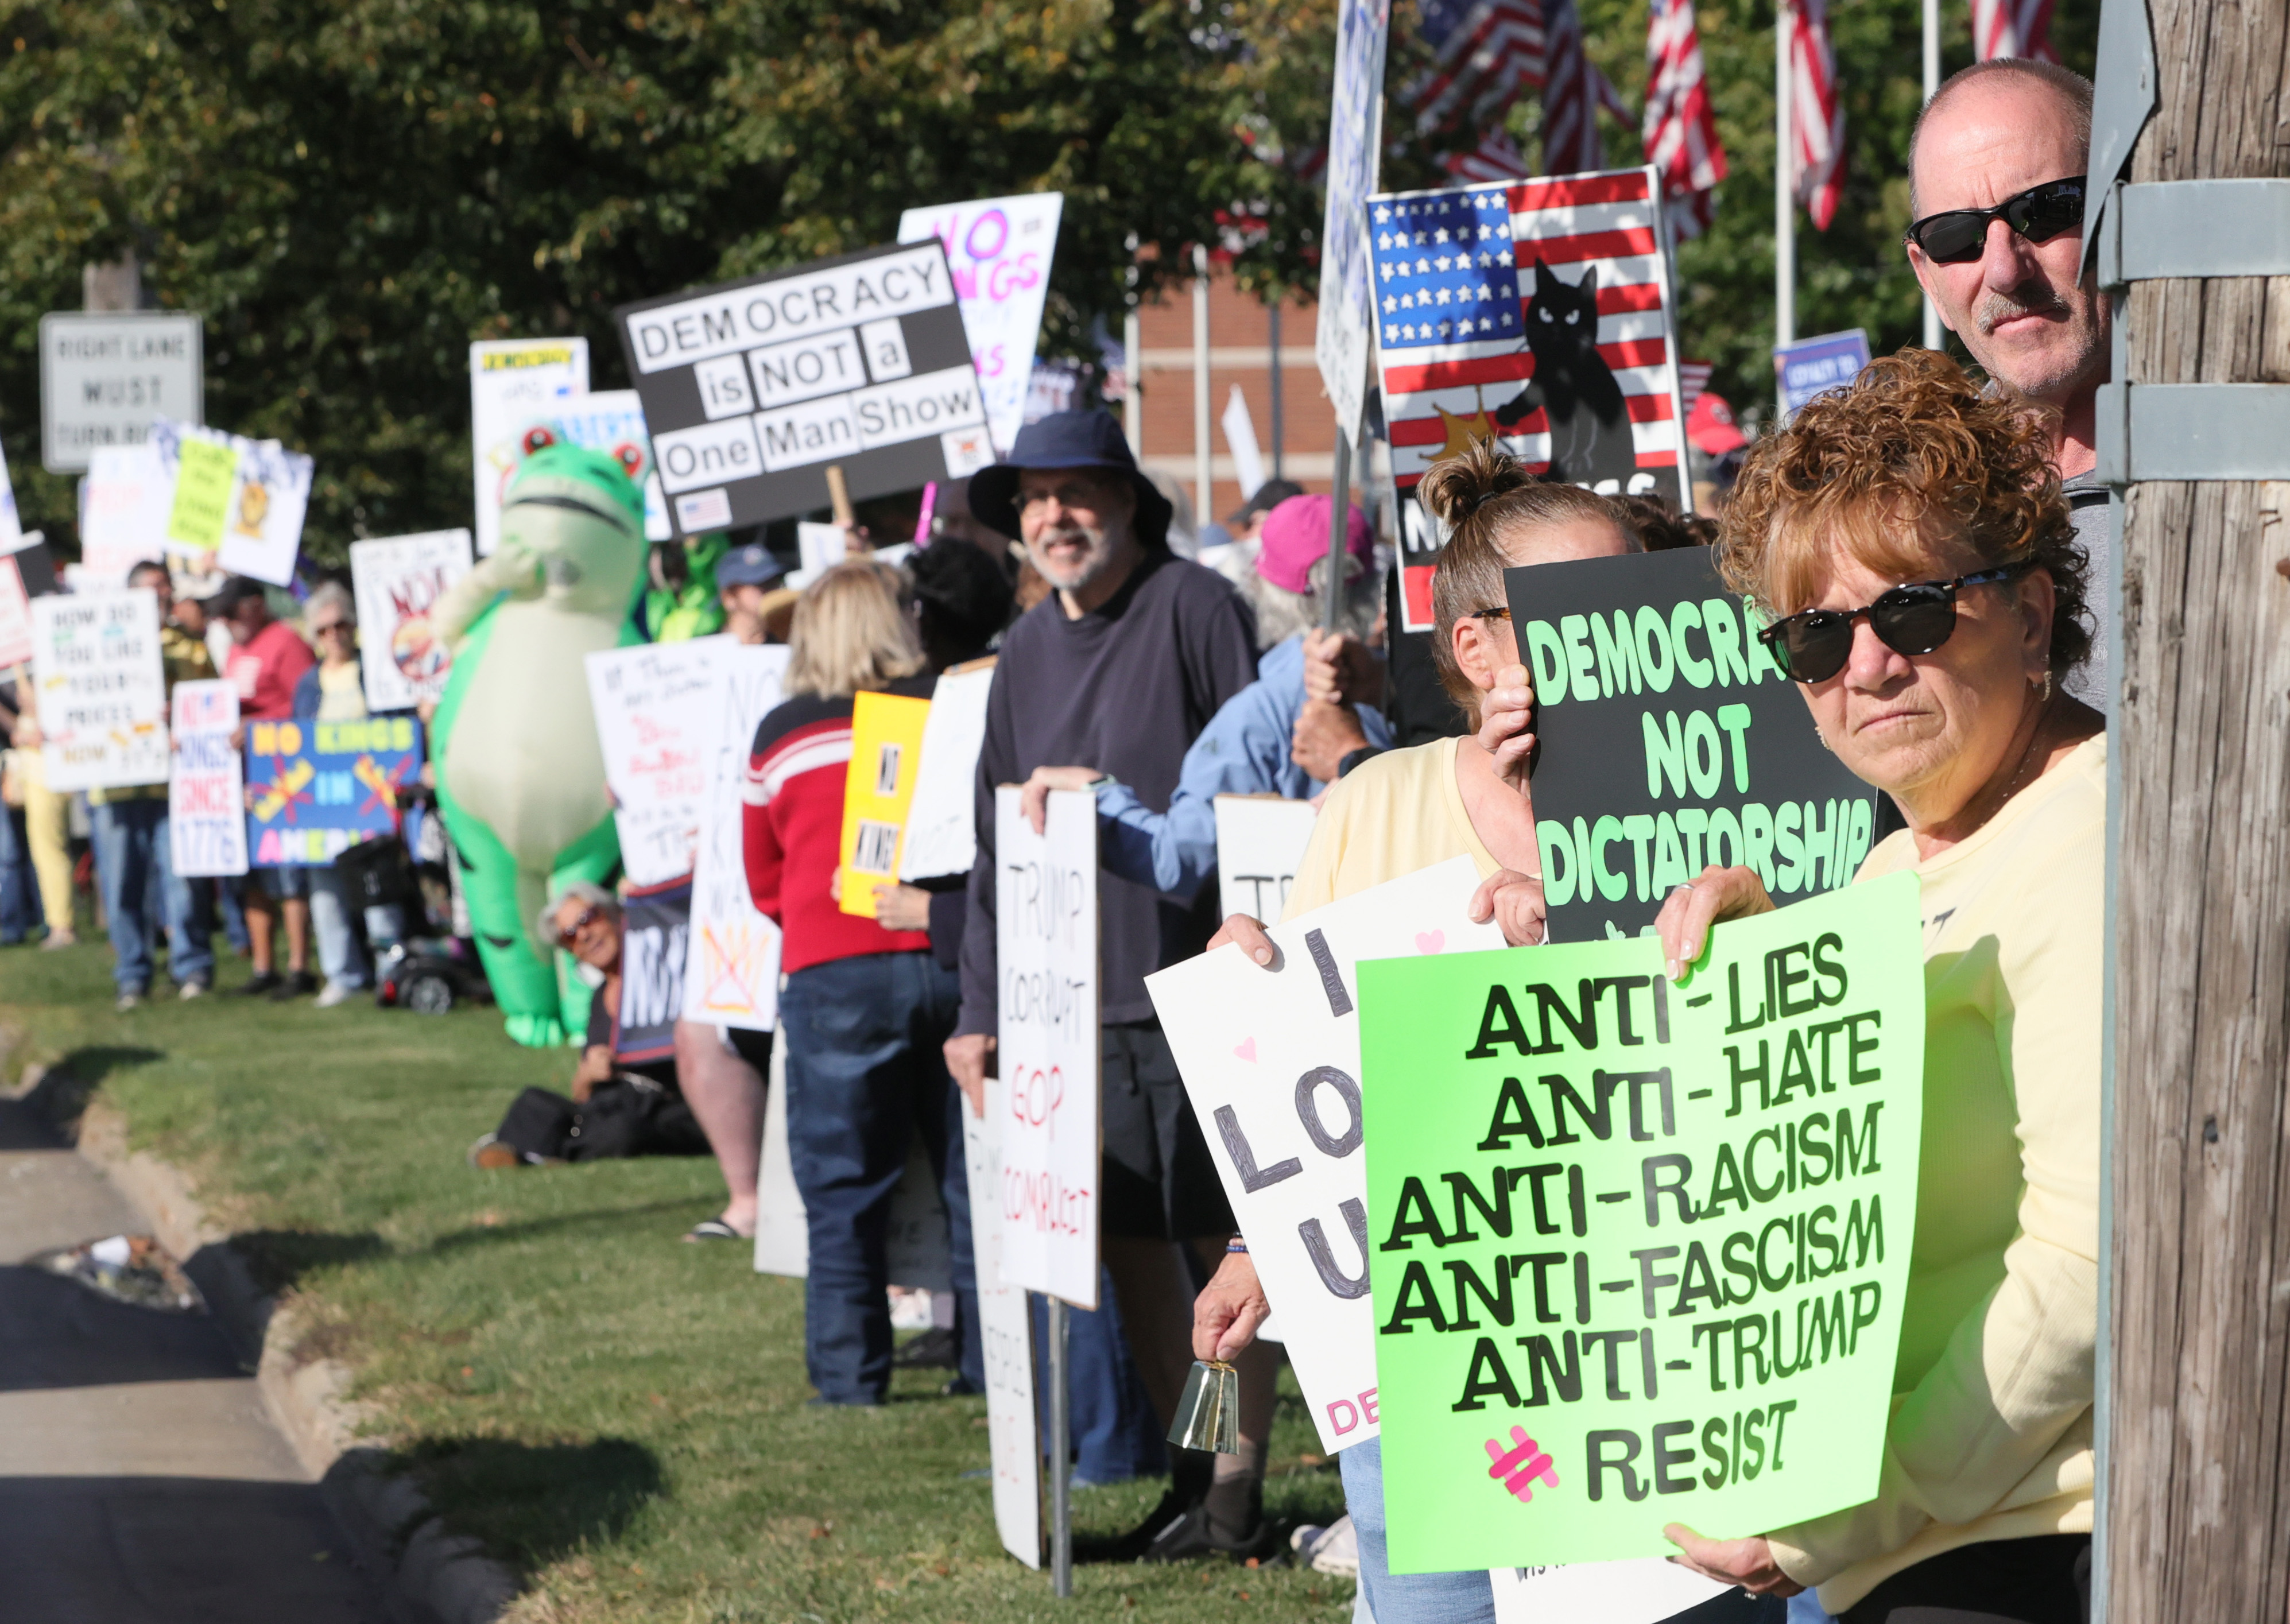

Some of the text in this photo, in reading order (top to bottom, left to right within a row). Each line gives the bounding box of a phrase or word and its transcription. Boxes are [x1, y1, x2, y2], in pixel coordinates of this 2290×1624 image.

[59, 335, 184, 359] RIGHT LANE
[638, 259, 940, 361] DEMOCRACY
[84, 376, 161, 405] MUST
[706, 340, 901, 405] is NOT a
[665, 433, 749, 479] One
[765, 413, 854, 458] Man
[860, 387, 974, 438] Show
[52, 603, 135, 627] HOW DO
[54, 640, 142, 665] YOU LIKE
[1526, 595, 1789, 707] DEMOCRA
[252, 716, 413, 757] NO KINGS
[1641, 703, 1752, 800] NOT
[180, 777, 231, 816] SINCE
[314, 770, 355, 805] IN
[179, 817, 236, 868] 1776
[1536, 797, 1872, 906] DICTATORSHIP
[1009, 861, 1086, 952] TRUMP
[1004, 966, 1086, 1044] CORRUPT
[1304, 927, 1354, 1017] I
[1012, 1063, 1065, 1142] GOP
[1213, 1065, 1363, 1194] LO
[1379, 1100, 1885, 1251] ANTI-RACISM
[1379, 1193, 1885, 1335] ANTI-FASCISM
[1451, 1281, 1882, 1412] ANTI-TRUMP
